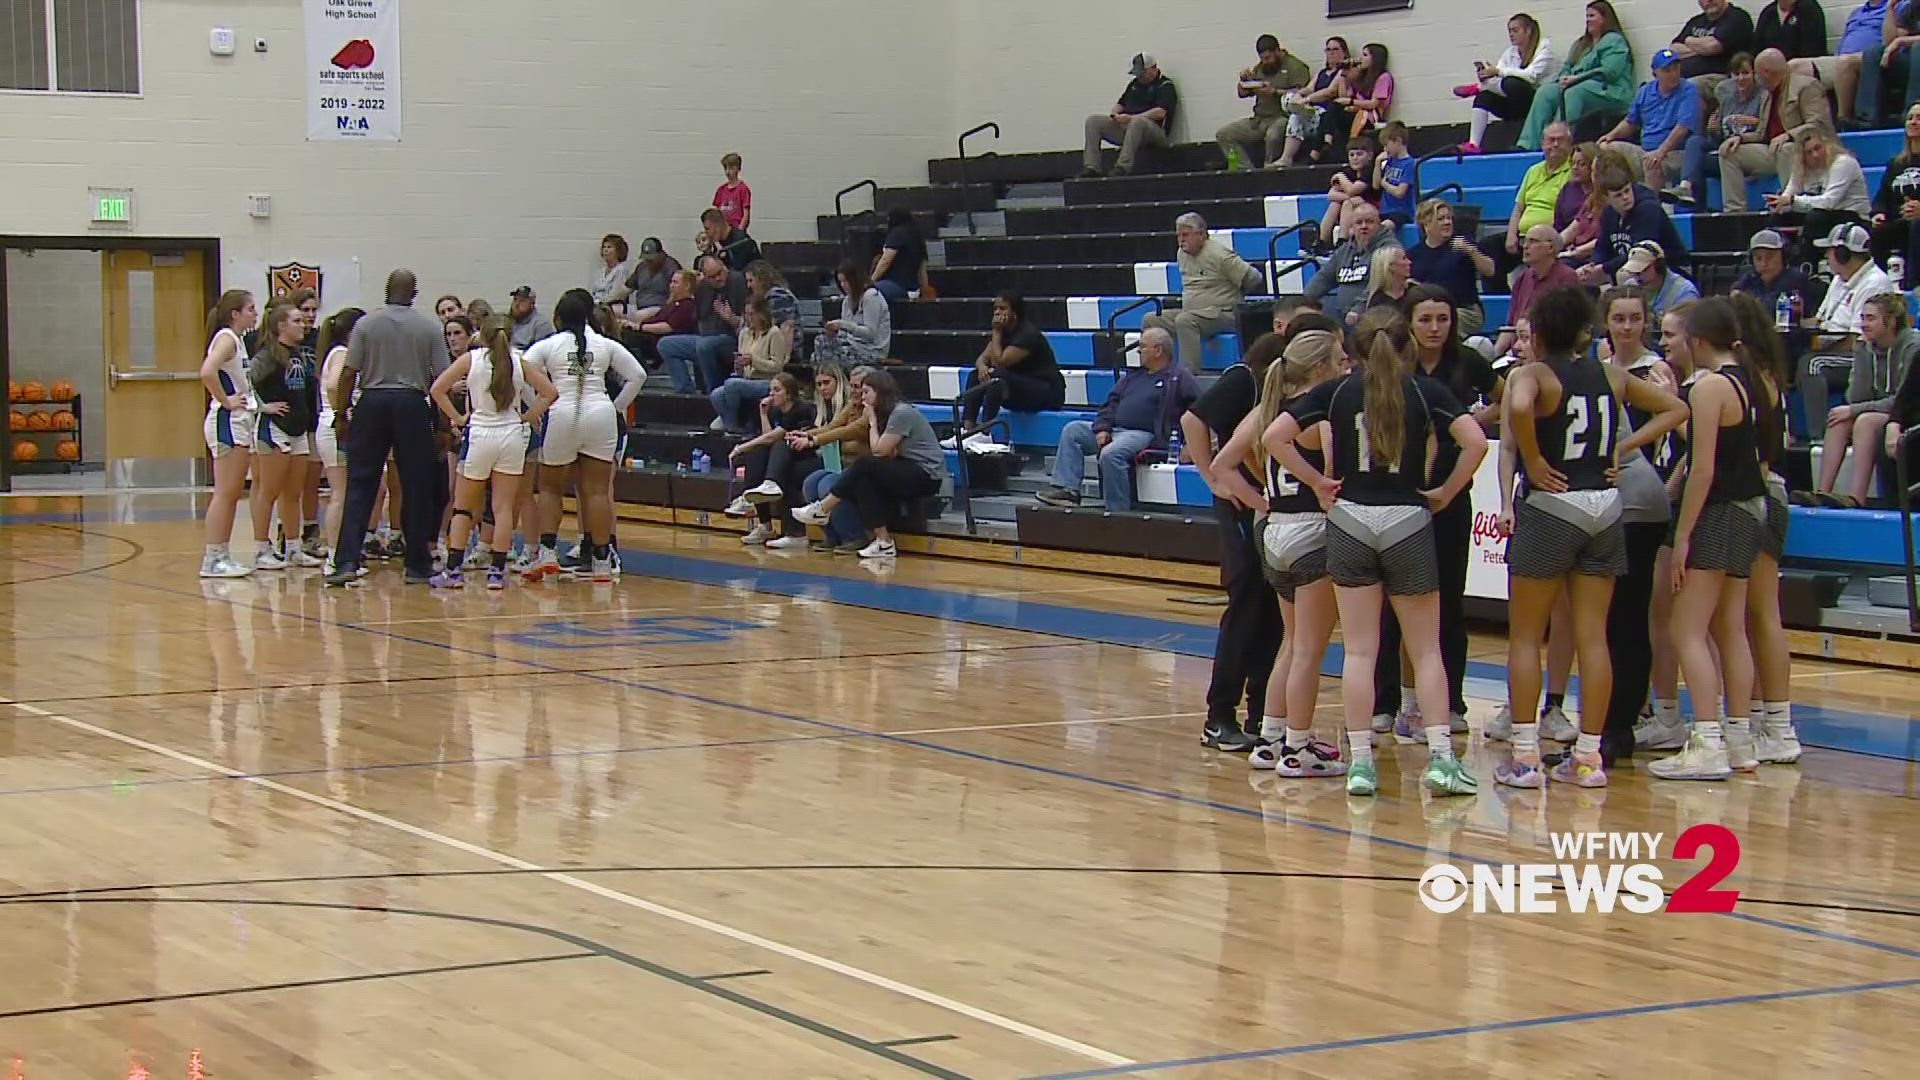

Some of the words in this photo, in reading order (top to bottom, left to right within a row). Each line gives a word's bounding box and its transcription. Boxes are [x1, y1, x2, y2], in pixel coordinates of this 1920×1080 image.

[326, 9, 345, 19] High
[347, 10, 376, 19] School
[320, 69, 335, 79] safe
[337, 71, 360, 80] sports
[361, 70, 385, 80] school
[320, 98, 348, 109] 2019
[358, 98, 385, 110] 2022
[99, 198, 124, 218] EXIT
[1563, 394, 1611, 461] 21
